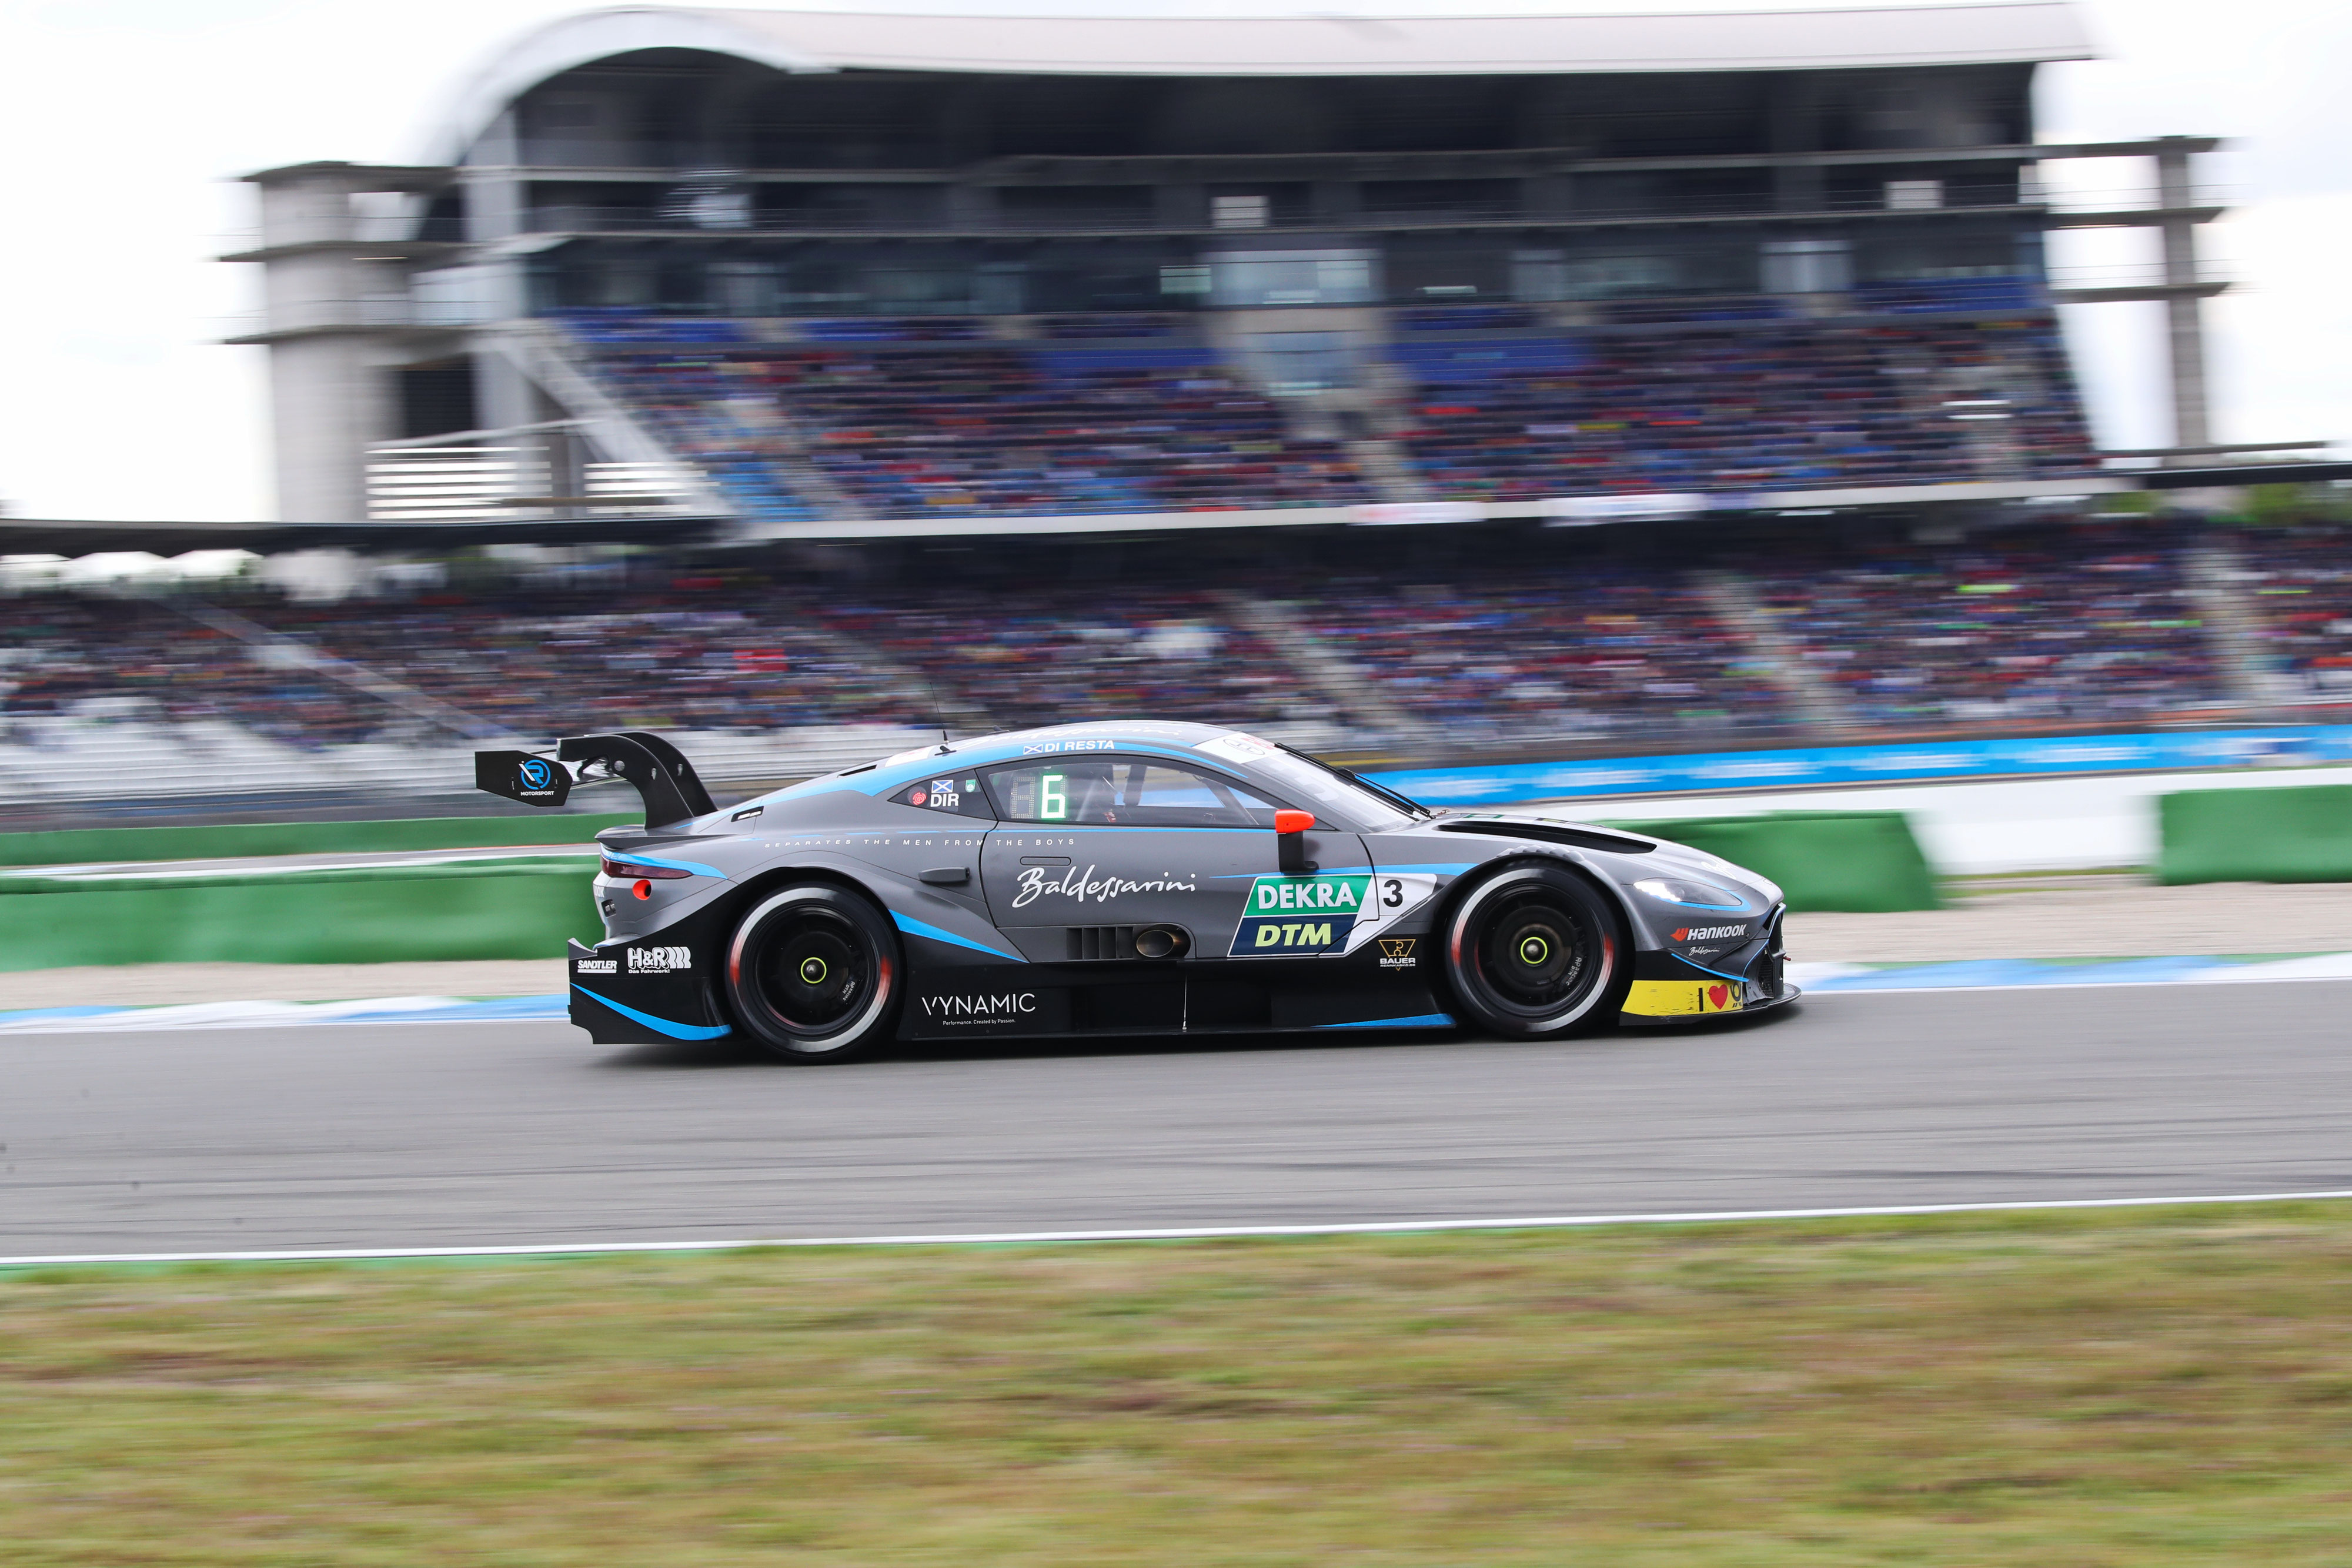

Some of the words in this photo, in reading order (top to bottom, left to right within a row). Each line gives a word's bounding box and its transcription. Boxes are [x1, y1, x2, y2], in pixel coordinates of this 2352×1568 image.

[1044, 743, 1060, 753] DI
[1064, 740, 1115, 751] RESTA
[930, 793, 960, 808] DIR
[1041, 774, 1067, 819] 6
[764, 839, 851, 848] SEPARATES
[1011, 864, 1196, 908] Baldessarini
[1257, 882, 1358, 910] DEKRA
[1383, 880, 1404, 908] 3
[1254, 922, 1331, 947] DTM
[577, 959, 617, 969] SANDTLER
[627, 947, 670, 969] H&R
[921, 993, 1036, 1016] VYNAMIC
[1698, 987, 1704, 1012] I
